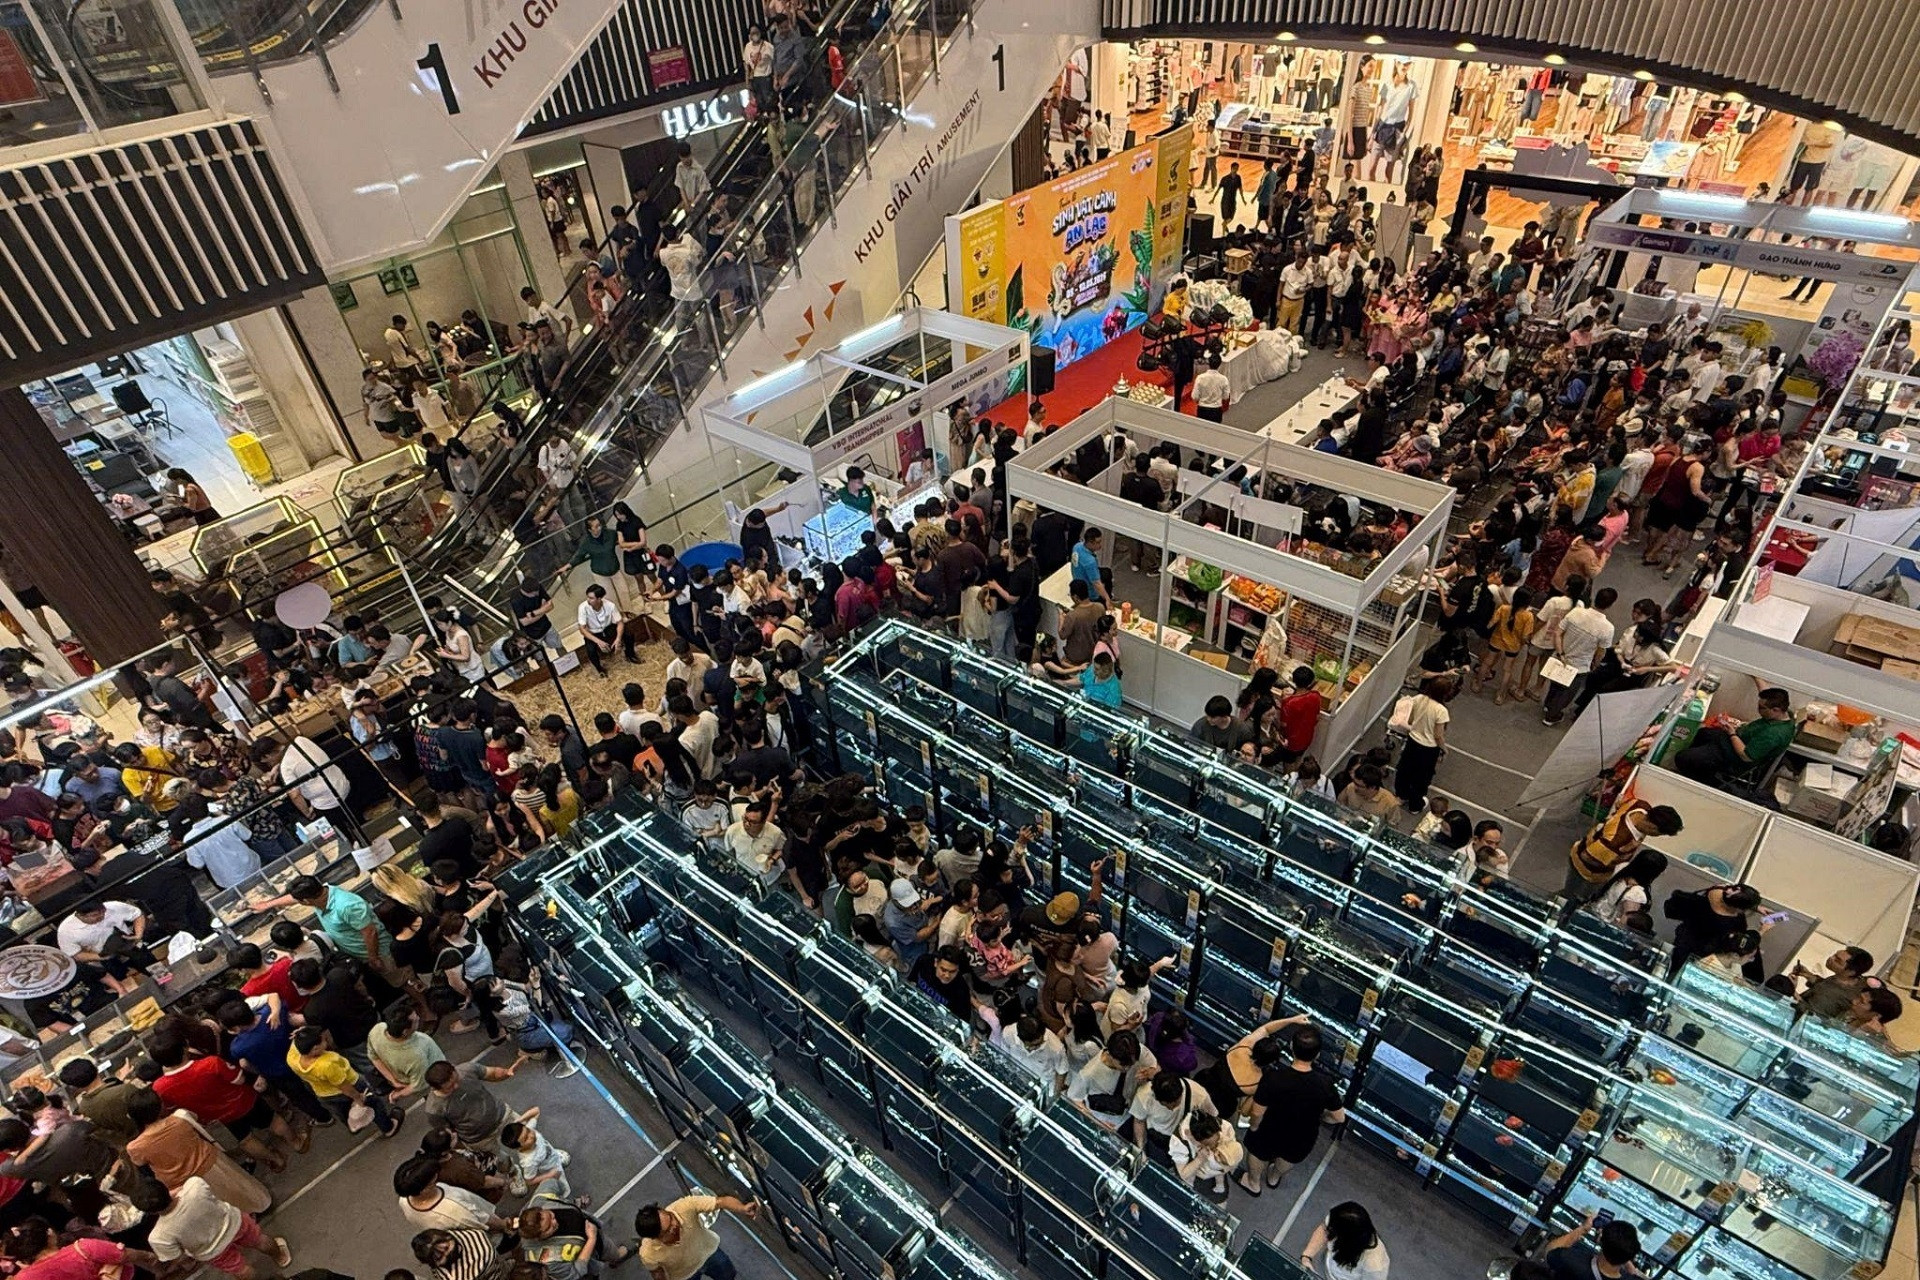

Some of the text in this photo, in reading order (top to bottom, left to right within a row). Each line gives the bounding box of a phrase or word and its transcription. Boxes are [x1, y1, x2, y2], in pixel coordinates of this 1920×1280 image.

[416, 43, 461, 115] 1
[473, 21, 527, 89] KHU
[991, 44, 1005, 92] 1
[854, 88, 981, 264] KHU GIẢI TRÍ AMUSEMENT
[1052, 204, 1076, 234] SINH
[1066, 215, 1107, 247] AN LẠC
